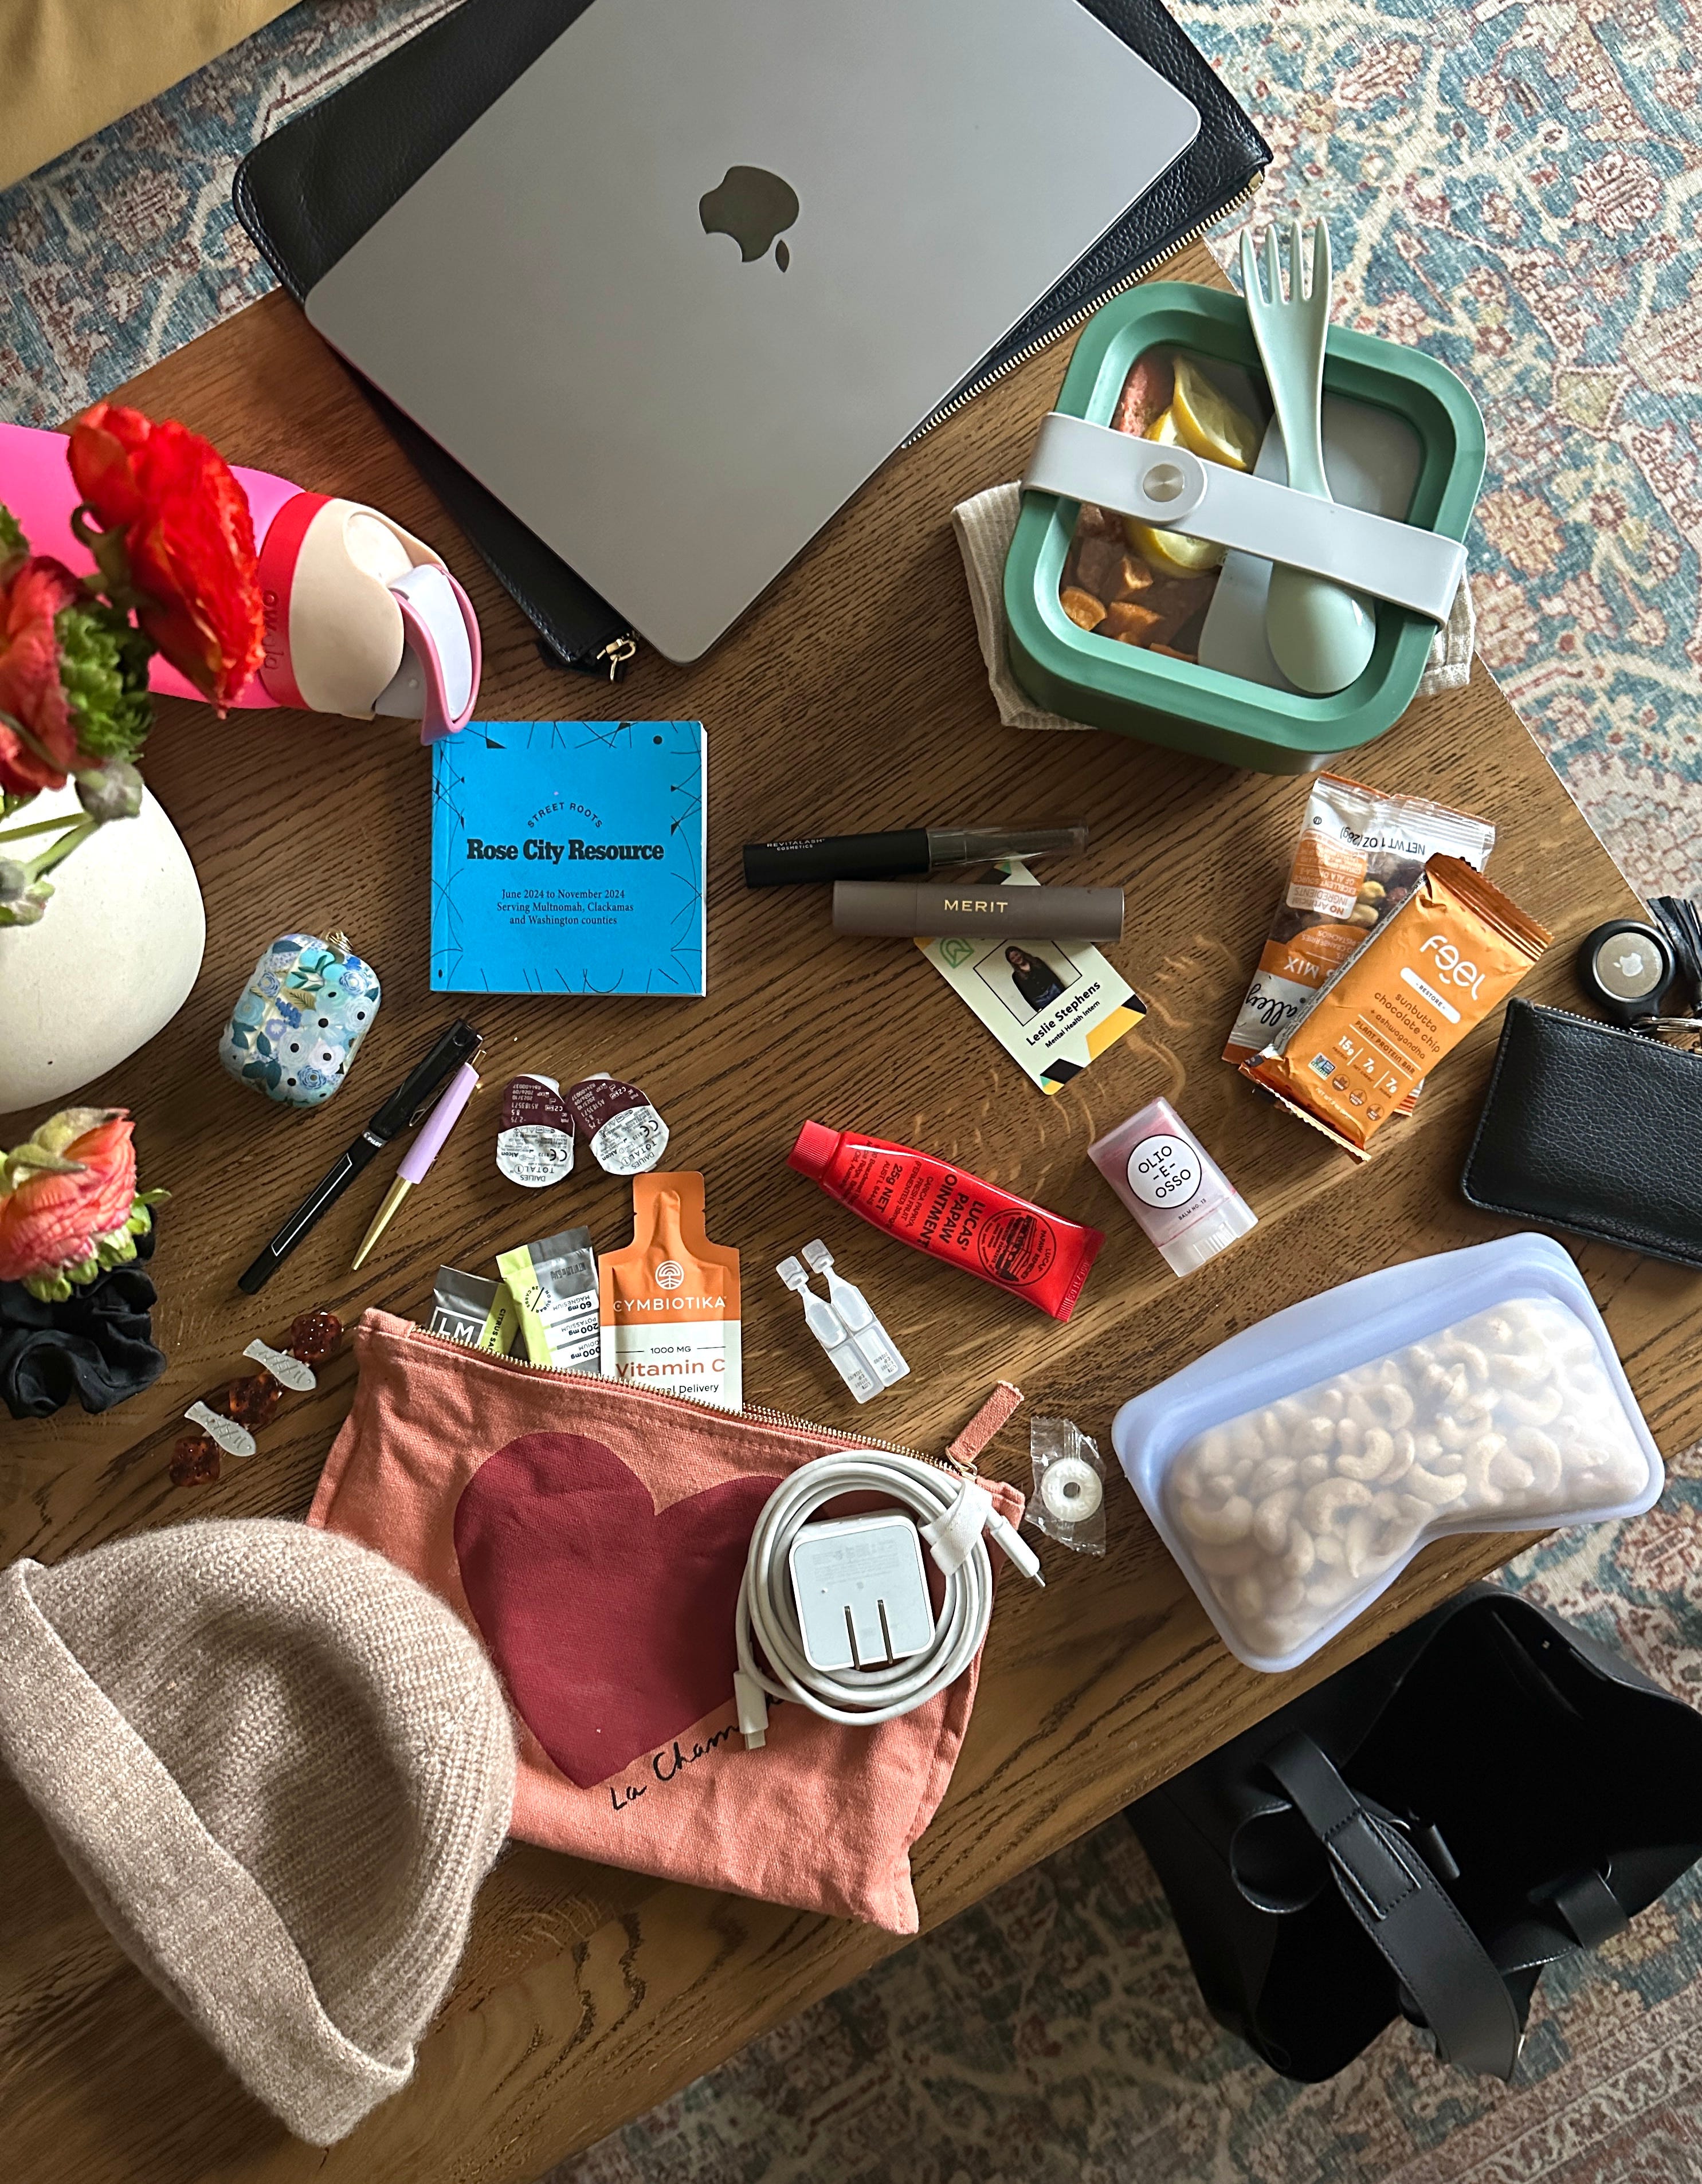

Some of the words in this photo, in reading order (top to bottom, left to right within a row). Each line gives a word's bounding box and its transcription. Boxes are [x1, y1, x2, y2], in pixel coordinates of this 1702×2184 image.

[527, 802, 564, 828] STREET
[570, 803, 602, 828] ROOTS
[1340, 825, 1363, 845] (28g)
[1362, 836, 1378, 848] OZ
[1381, 837, 1386, 847] 1
[1387, 838, 1404, 850] WT
[466, 839, 517, 859] Rose
[523, 839, 564, 865] City
[568, 839, 664, 860] Resource
[1406, 842, 1425, 854] NET
[501, 889, 521, 899] June
[524, 890, 544, 898] 2024
[546, 890, 555, 898] to
[558, 889, 602, 898] November
[605, 889, 625, 898] 2024
[1290, 883, 1349, 905] INGREDIENTS
[497, 902, 530, 913] Serving
[532, 902, 585, 912] Multnomah,
[587, 902, 634, 911] Clackamas
[943, 898, 1009, 913] MERIT
[1327, 902, 1344, 915] NO
[509, 915, 526, 924] and
[528, 916, 579, 926] Washington
[581, 916, 617, 924] counties
[1283, 955, 1319, 977] MIX
[1419, 935, 1485, 1001] feel
[1414, 985, 1446, 1007] RESTORE
[1026, 1020, 1056, 1046] Leslie
[1054, 982, 1101, 1022] Stephens
[1240, 980, 1301, 1034] alley
[1389, 993, 1437, 1033] sunbutta
[1045, 1029, 1065, 1048] Mental
[1064, 1015, 1084, 1032] Health
[1082, 1001, 1100, 1016] Intern
[1374, 992, 1427, 1035] chocolate
[1421, 1034, 1440, 1052] chip
[1371, 1014, 1425, 1059] ashwagandha
[1354, 1020, 1376, 1039] PLANT
[1375, 1039, 1402, 1063] PROTEIN
[1402, 1062, 1415, 1075] BAR
[1338, 1035, 1354, 1056] 15g
[1363, 1058, 1374, 1073] 7g
[1386, 1078, 1398, 1093] 7g
[367, 1136, 383, 1148] PILOT
[601, 1148, 618, 1162] Alcon
[630, 1151, 655, 1169] DAILIES
[1138, 1146, 1172, 1173] OLIO
[884, 1162, 904, 1187] 25g
[894, 1159, 924, 1206] (FERMENTED)
[1155, 1169, 1191, 1198] OSSO
[908, 1176, 924, 1200] FRESH
[916, 1174, 935, 1202] CARICA
[873, 1185, 895, 1214] NET
[899, 1199, 915, 1221] FRUIT
[916, 1173, 958, 1250] OINTMENT
[942, 1191, 968, 1244] PAPAW
[1178, 1209, 1191, 1220] BALM
[522, 1289, 534, 1309] CARBS
[544, 1289, 551, 1299] NO
[551, 1294, 591, 1311] MAGNESIUM
[532, 1298, 554, 1314] SUGAR
[566, 1303, 579, 1313] mg
[578, 1300, 593, 1311] 60
[613, 1296, 724, 1313] CYMBIOTIKA
[438, 1316, 475, 1342] LM
[492, 1307, 507, 1336] CITRUS
[559, 1316, 598, 1333] POTASSIUM
[579, 1322, 599, 1335] 200
[567, 1327, 581, 1337] mg
[487, 1336, 496, 1348] SA
[577, 1339, 600, 1352] ODIUM
[650, 1346, 674, 1354] 1000
[569, 1351, 583, 1360] mg
[581, 1346, 602, 1358] 000
[616, 1360, 707, 1377] Vitamin
[711, 1358, 725, 1372] C
[679, 1382, 719, 1394] Delivery
[610, 1785, 648, 1810] La
[653, 1725, 740, 1781] Cham
